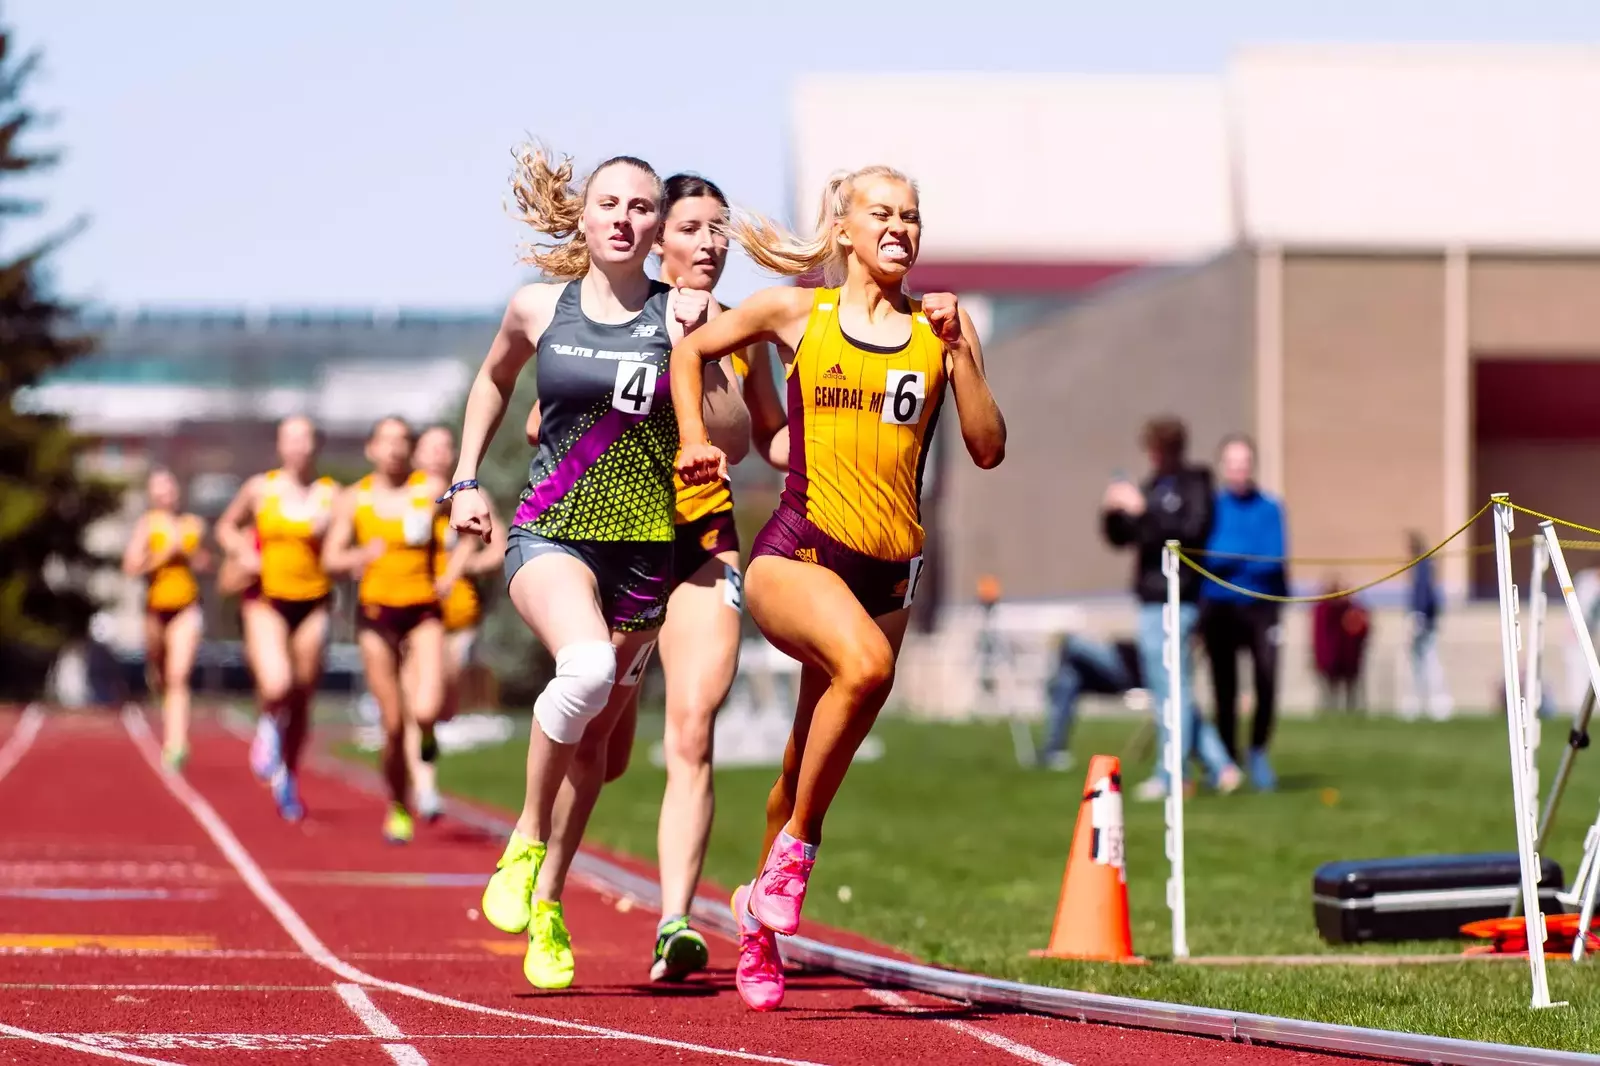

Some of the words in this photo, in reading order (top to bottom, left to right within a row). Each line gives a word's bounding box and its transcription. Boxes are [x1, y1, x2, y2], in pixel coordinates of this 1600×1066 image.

[621, 366, 647, 411] 4
[823, 372, 847, 380] adidas
[815, 386, 864, 411] CENTRAL
[893, 374, 918, 423] 6
